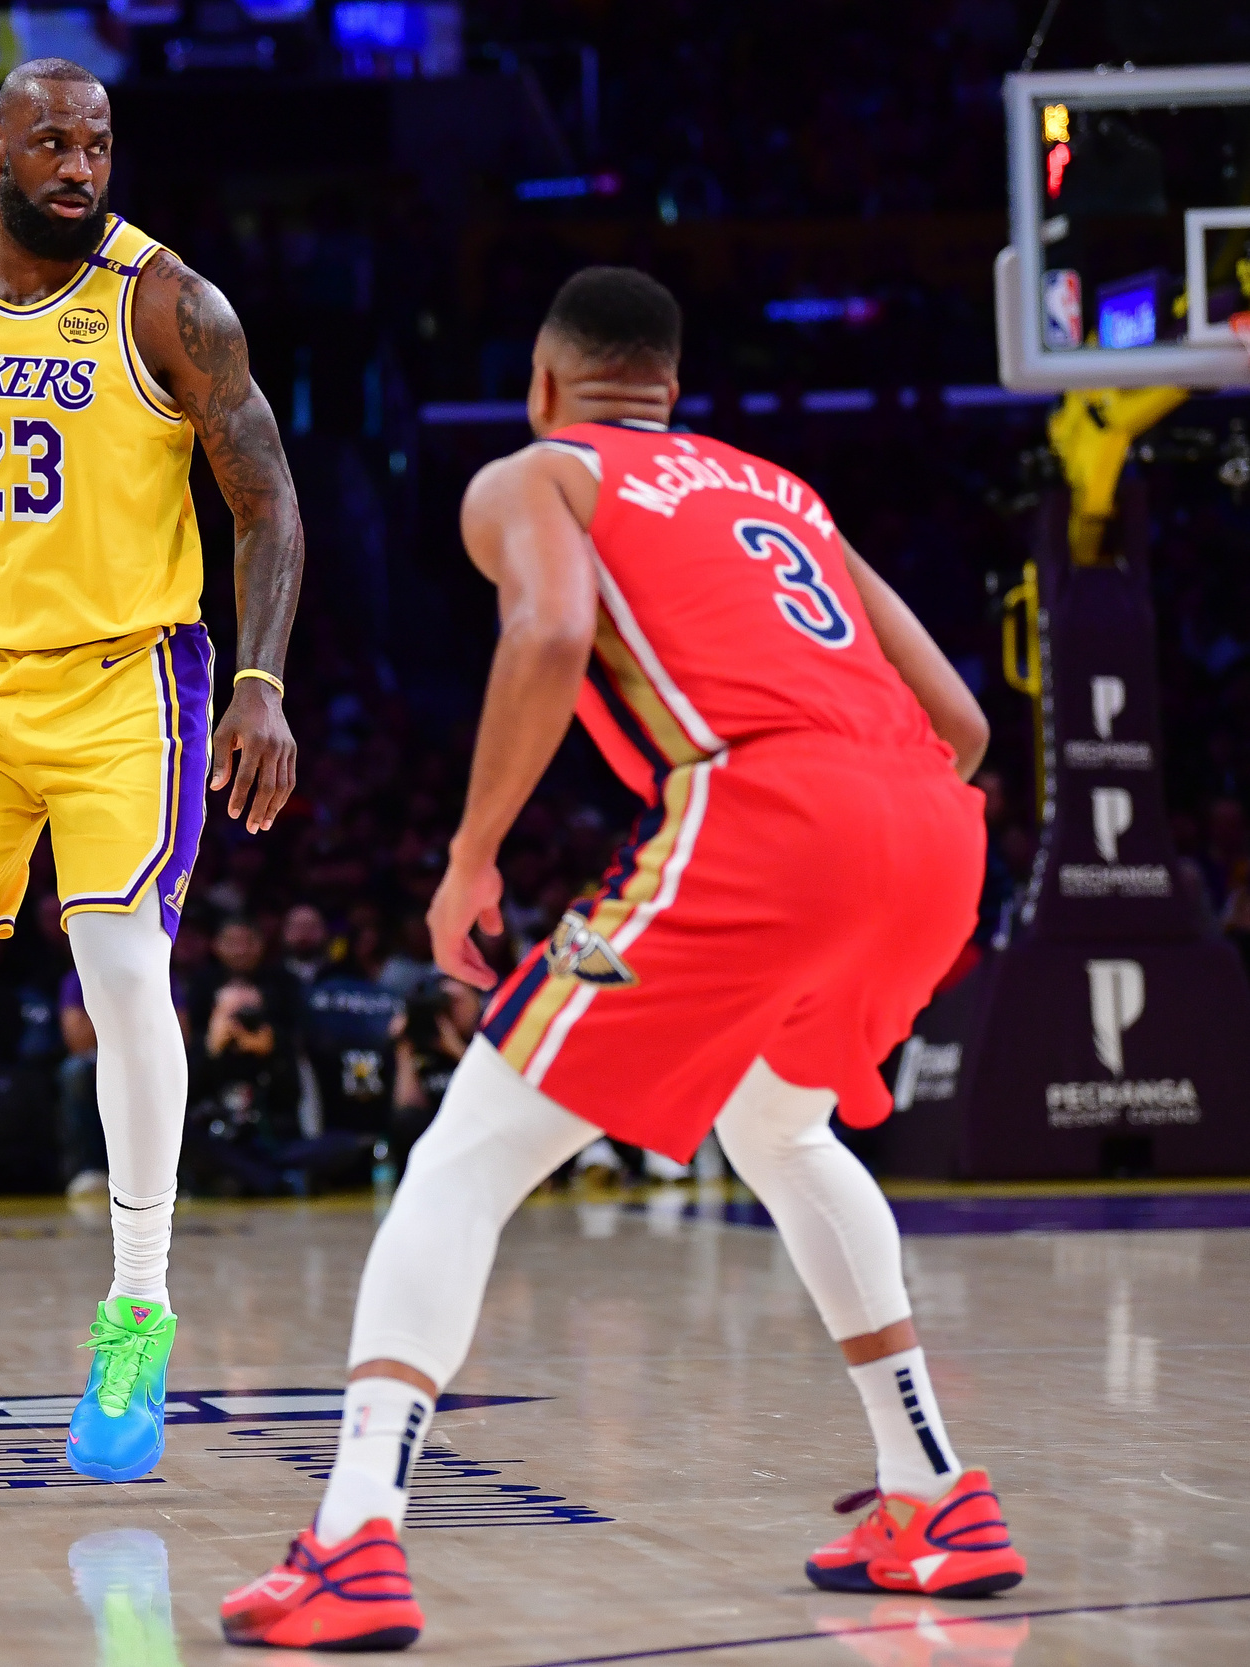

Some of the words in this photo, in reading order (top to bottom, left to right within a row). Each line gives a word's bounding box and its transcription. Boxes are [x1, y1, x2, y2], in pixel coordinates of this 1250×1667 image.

[106, 260, 122, 272] 44
[63, 316, 106, 334] bibigo
[732, 518, 855, 650] 3
